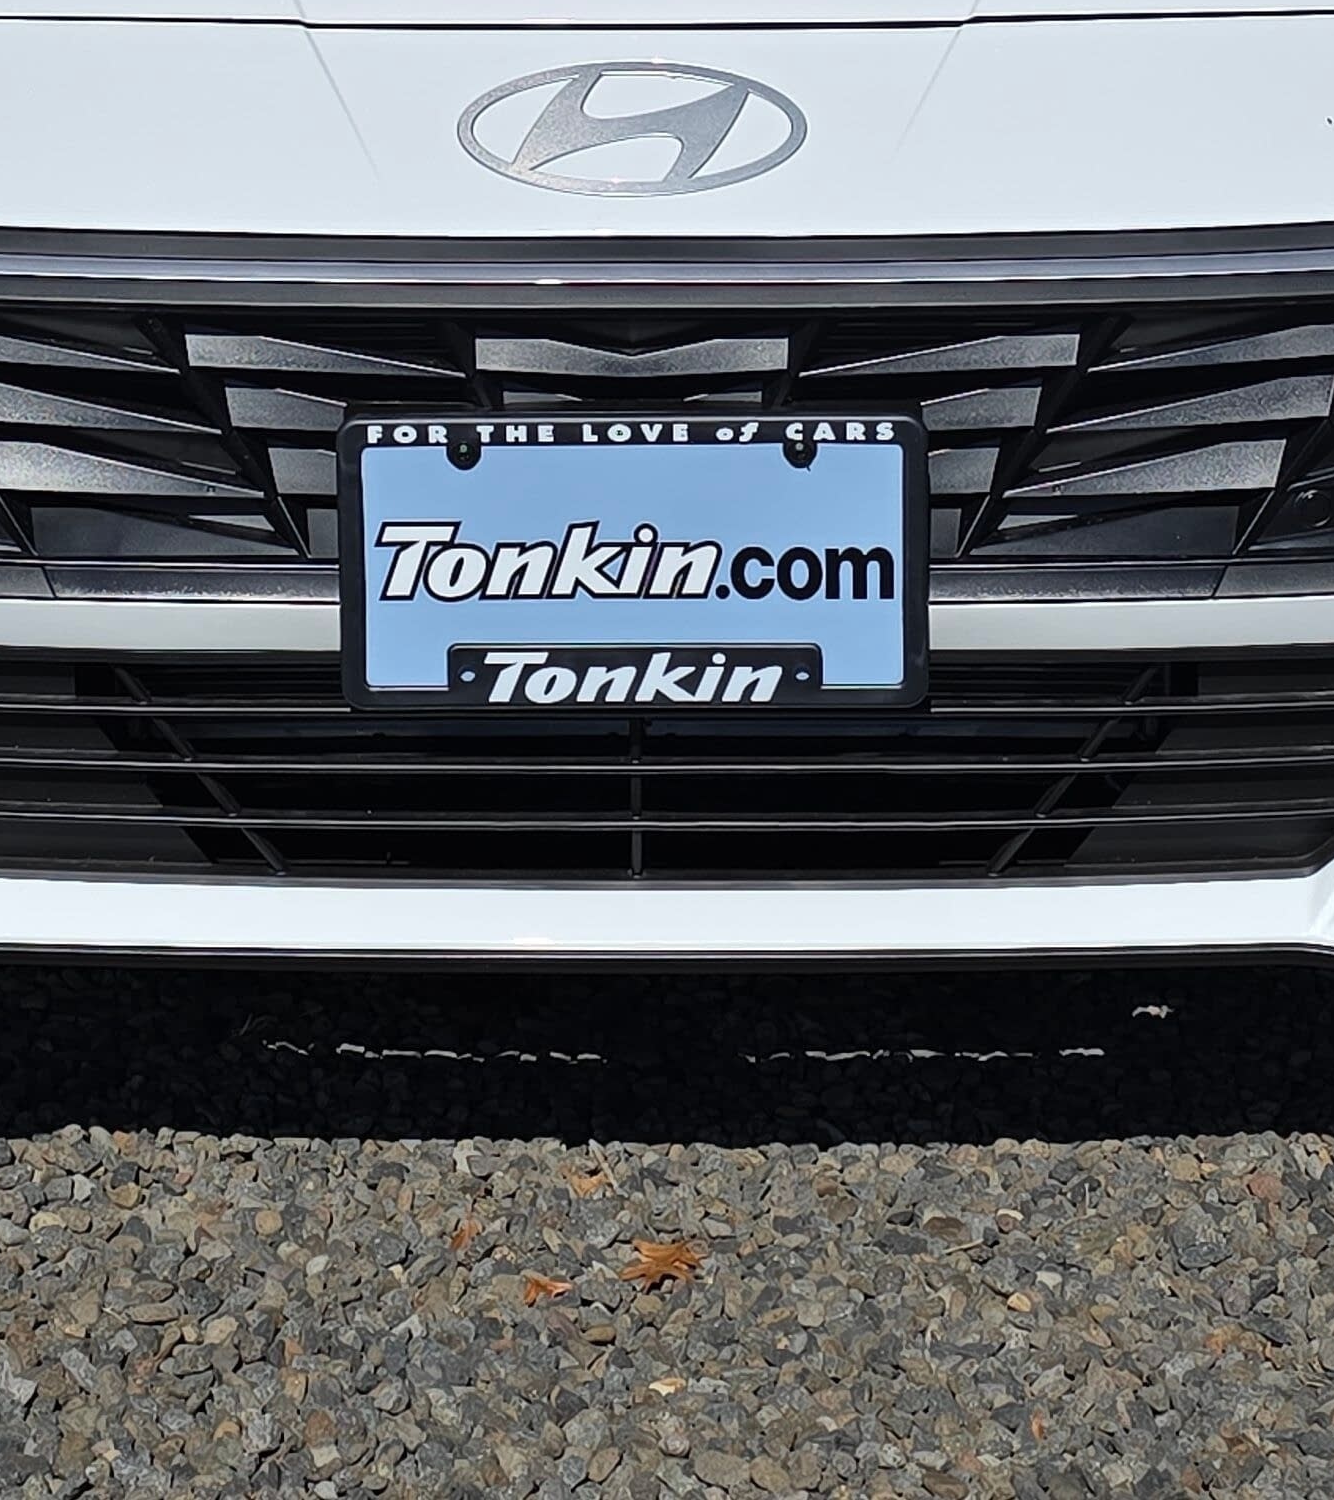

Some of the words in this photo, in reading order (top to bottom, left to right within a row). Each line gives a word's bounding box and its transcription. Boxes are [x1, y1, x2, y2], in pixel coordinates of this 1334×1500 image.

[368, 425, 449, 444] FOR
[476, 424, 555, 443] THE
[582, 423, 689, 443] LOVE
[785, 421, 896, 442] CARS
[374, 521, 896, 602] Tonkin.com
[483, 651, 783, 704] Tonkin
